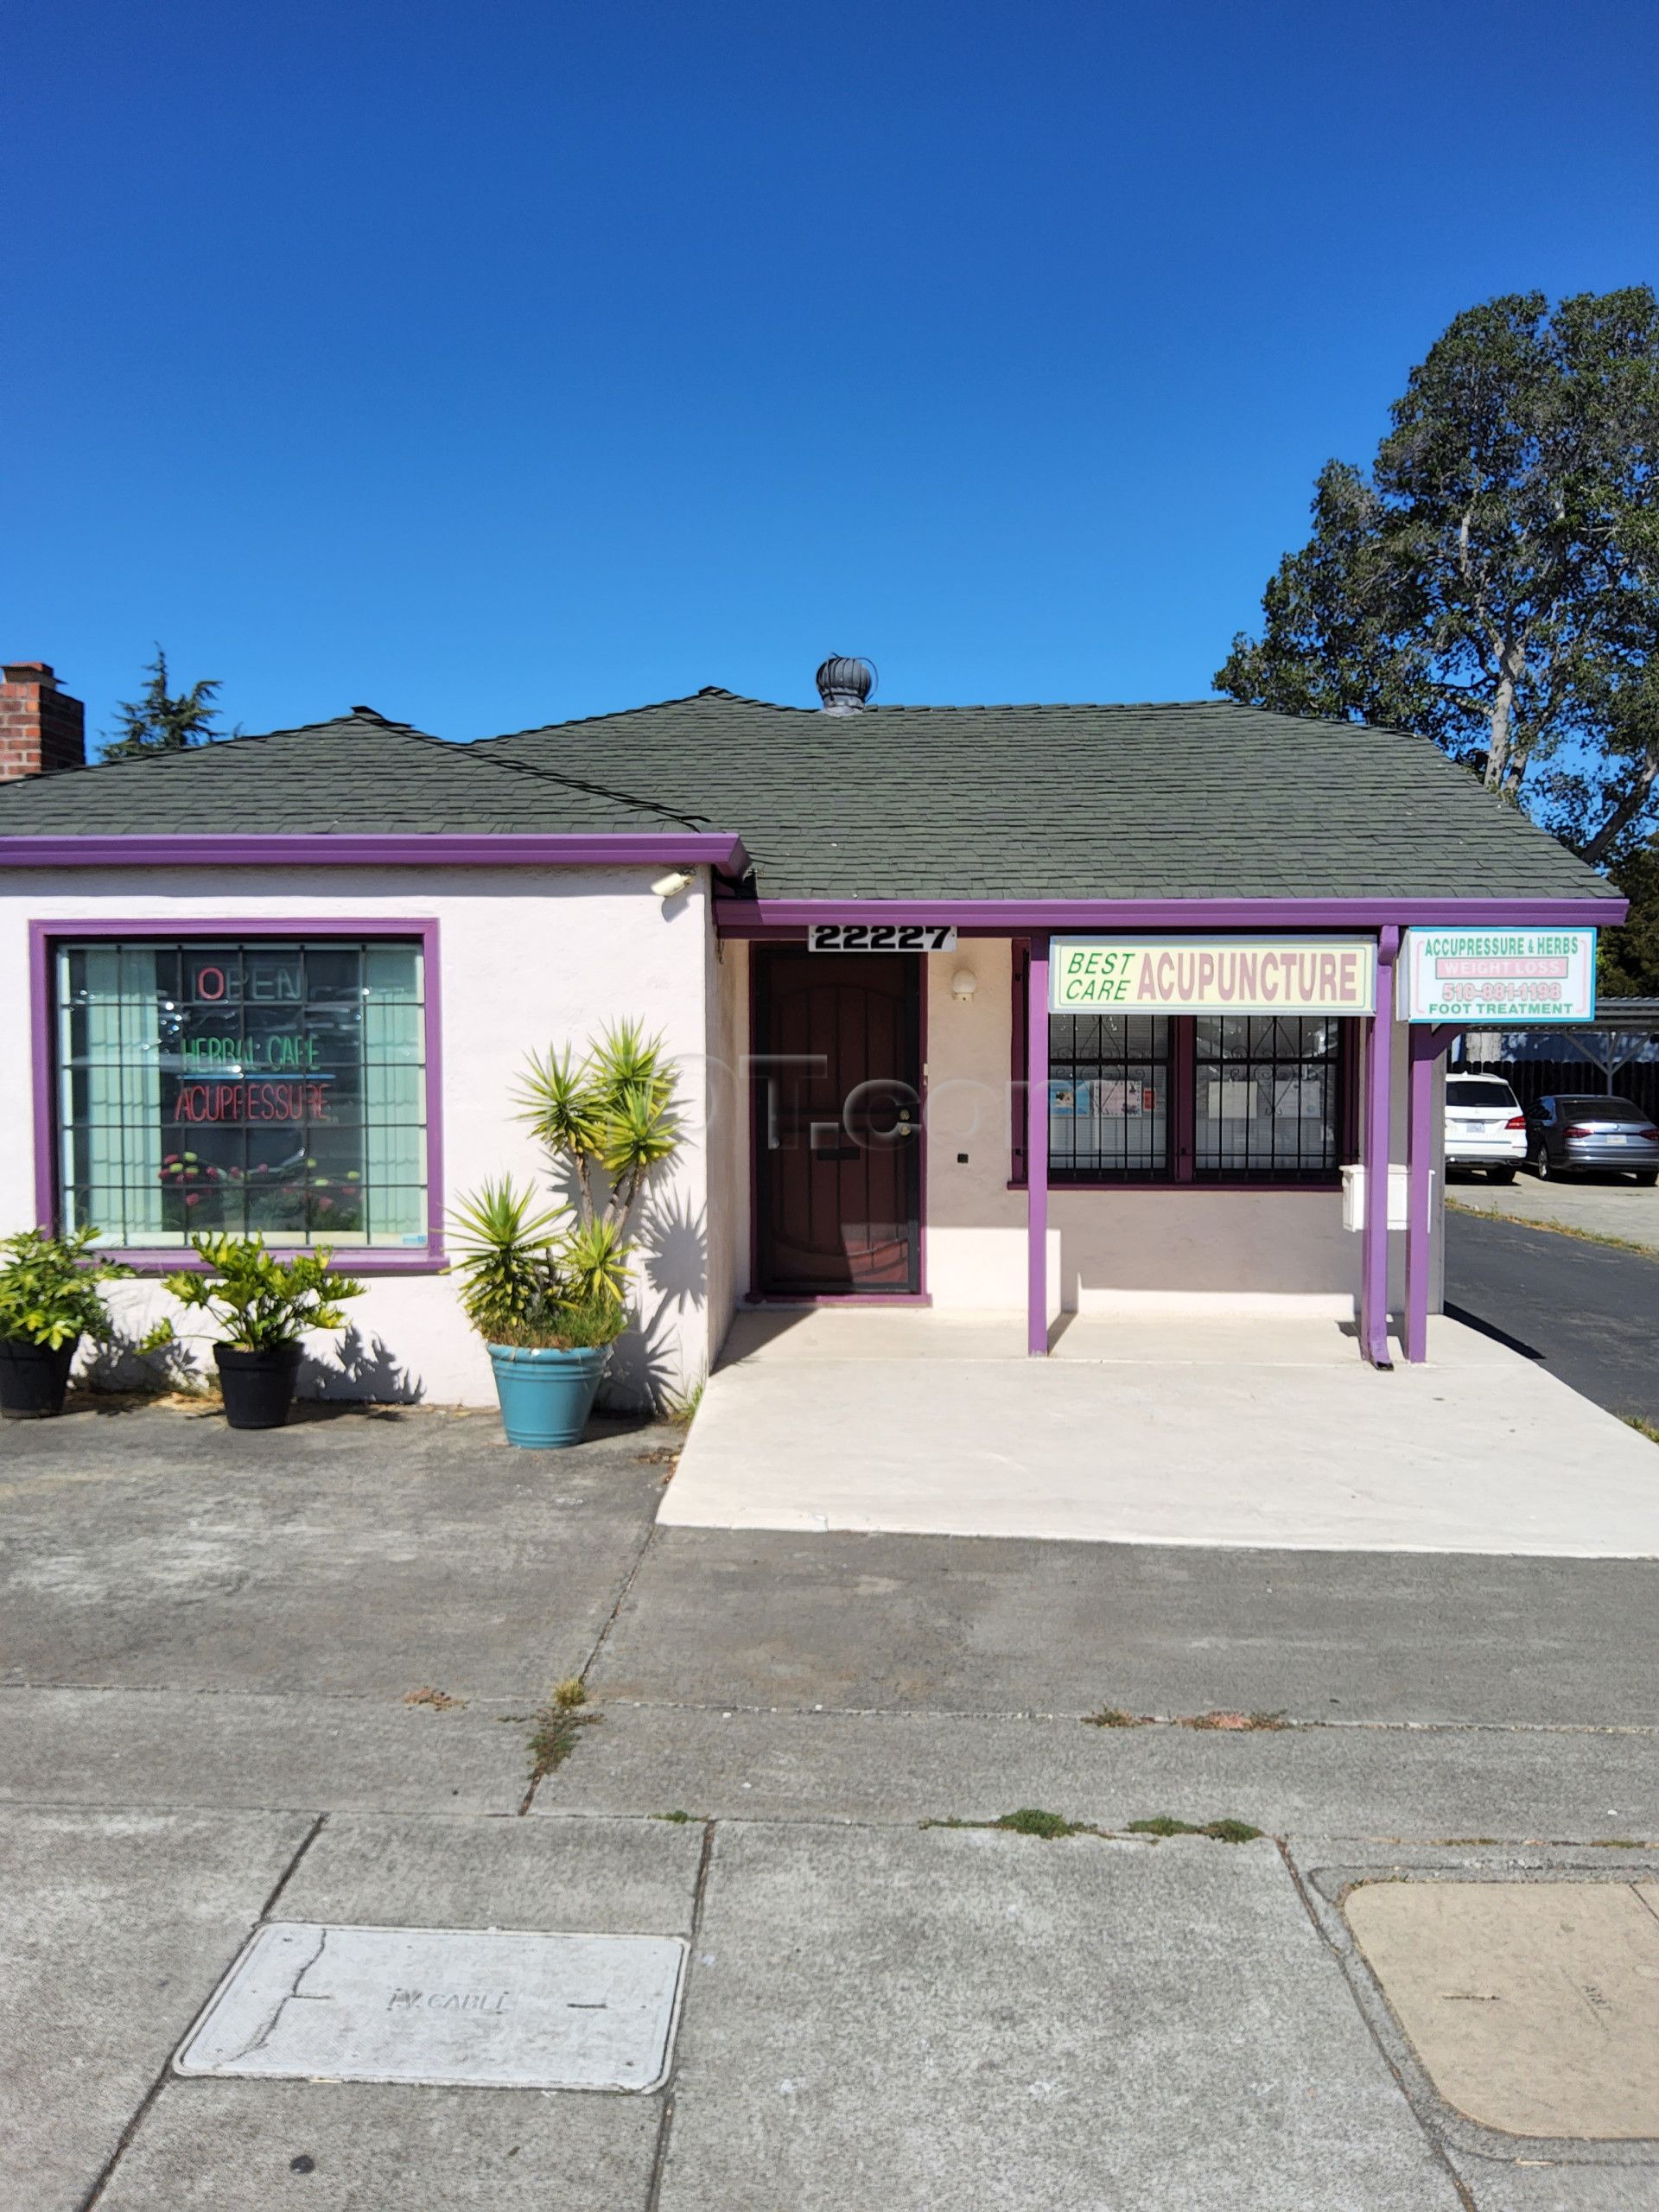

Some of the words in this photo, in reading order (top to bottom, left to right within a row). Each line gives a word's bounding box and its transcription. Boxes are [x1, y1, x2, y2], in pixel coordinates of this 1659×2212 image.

[815, 925, 951, 950] 22227
[1425, 938, 1524, 957] ACCUPRESSURE
[1537, 937, 1579, 955] HERBS
[1067, 952, 1135, 975] BEST
[1444, 961, 1511, 976] WEIGHT
[1516, 960, 1560, 975] LOSS
[198, 967, 302, 1000] OPEN
[1136, 951, 1357, 1001] ACUPUNCTURE
[1065, 979, 1131, 1001] CARE
[1429, 1003, 1471, 1014] FOOT
[1476, 1003, 1573, 1014] TREATMENT
[268, 1034, 321, 1071] CAFE
[175, 1083, 333, 1122] ACUPRESSURE
